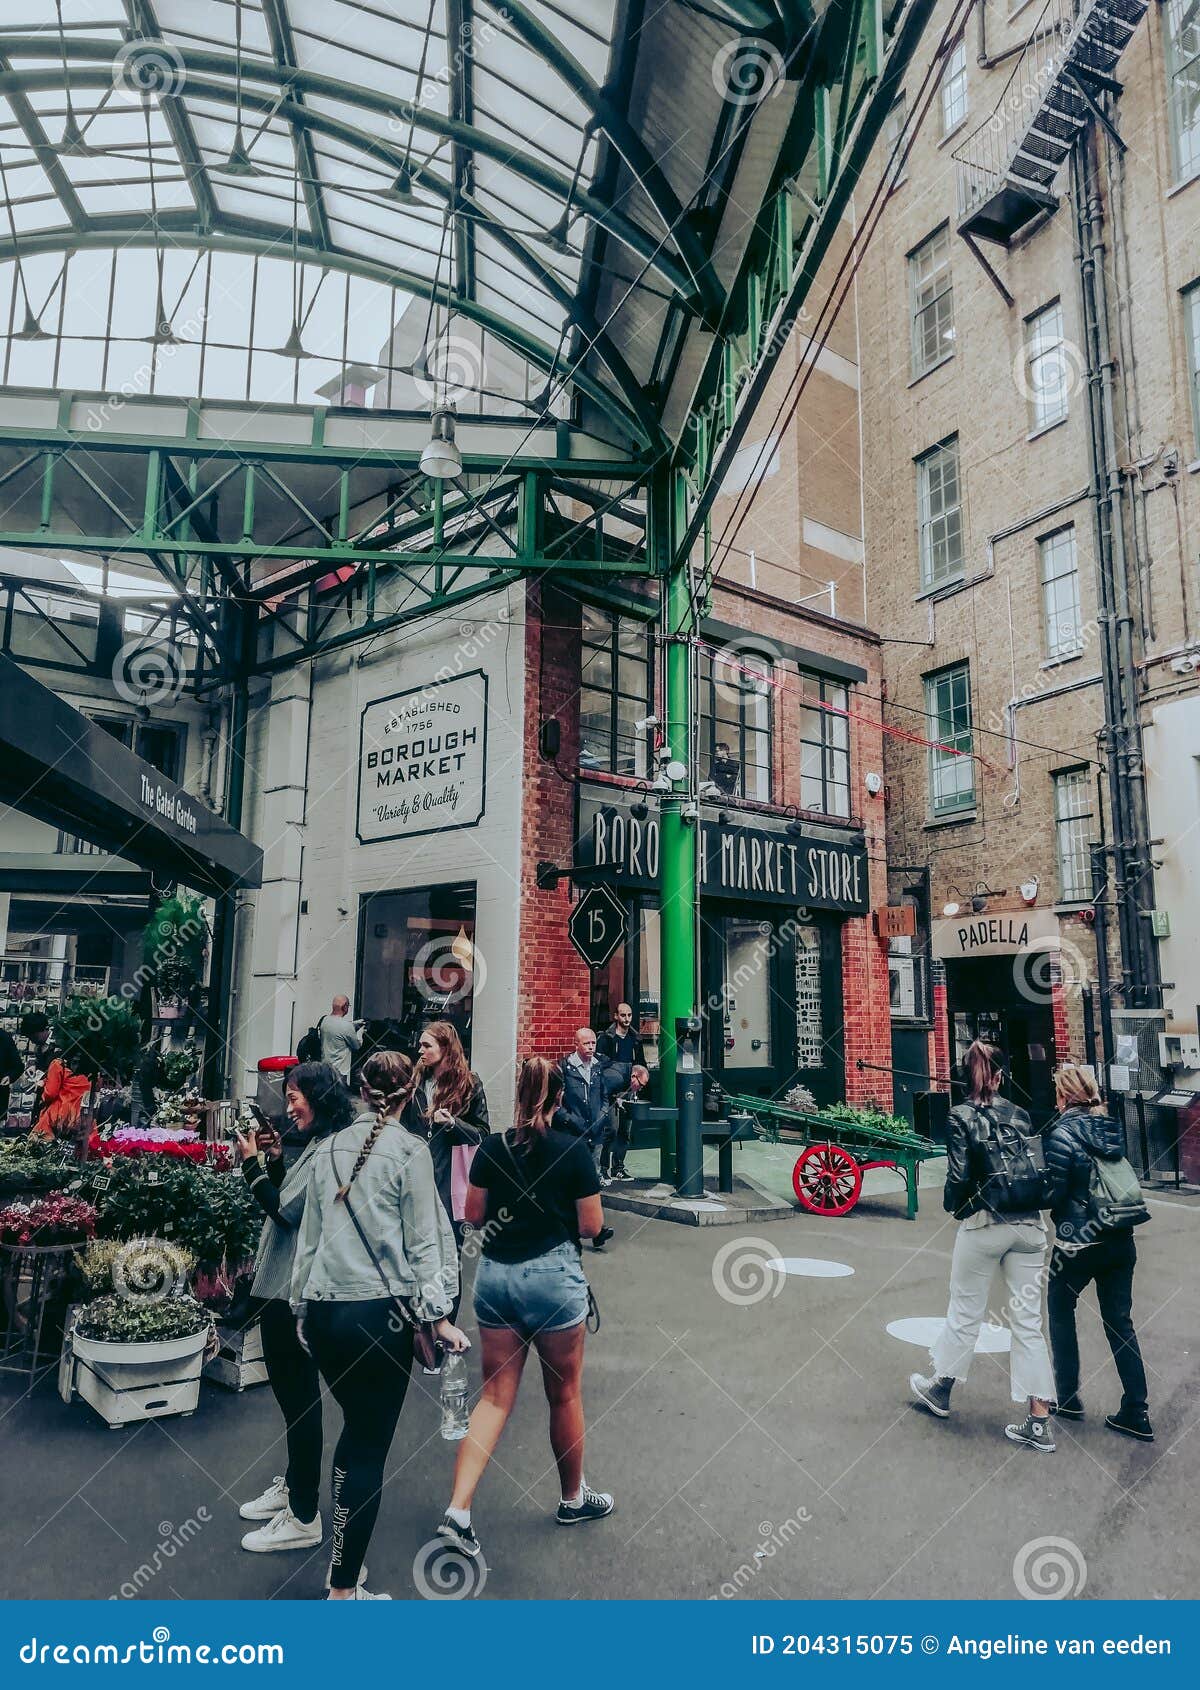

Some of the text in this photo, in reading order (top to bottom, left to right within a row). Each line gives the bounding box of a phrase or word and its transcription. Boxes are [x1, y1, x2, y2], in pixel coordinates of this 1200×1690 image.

[384, 702, 461, 734] ESTABLISHED
[407, 719, 433, 734] 1756
[367, 726, 477, 769] BOROUGH
[376, 753, 466, 788] MARKET
[141, 773, 197, 834] The Gated Garden
[411, 794, 420, 814] &
[595, 812, 862, 904] BOROH MARKET STORE
[587, 909, 606, 943] 15
[957, 919, 1029, 951] PADELLA
